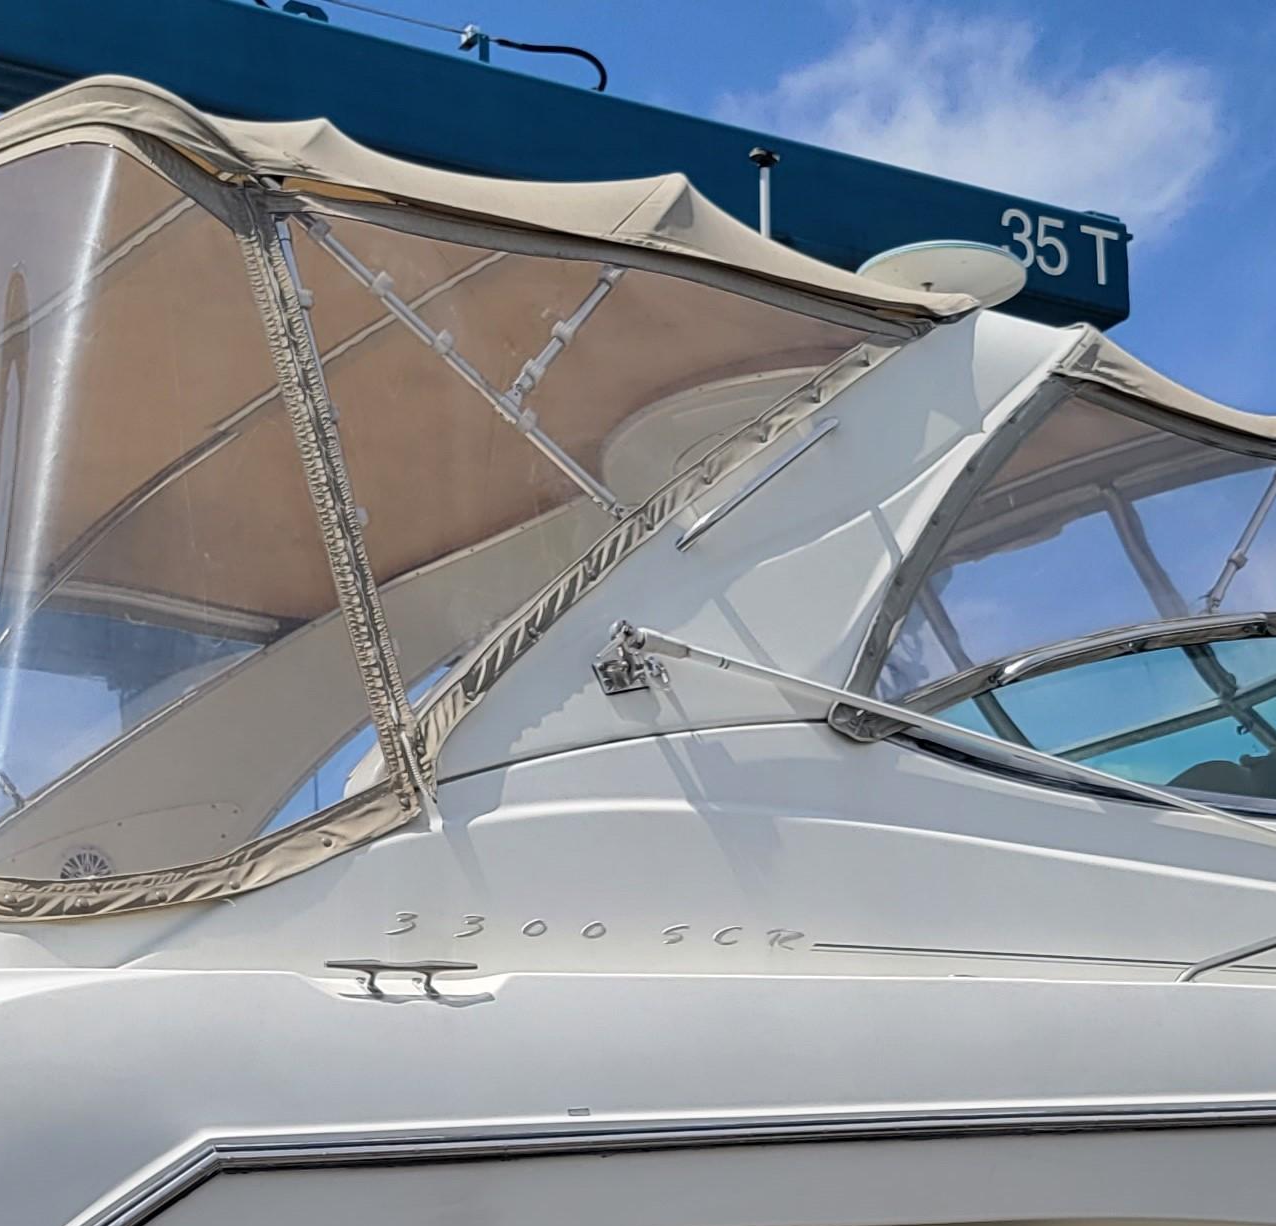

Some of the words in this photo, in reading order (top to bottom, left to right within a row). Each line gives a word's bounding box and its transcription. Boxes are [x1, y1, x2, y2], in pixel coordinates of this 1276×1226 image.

[1000, 208, 1069, 276] 35
[1080, 225, 1119, 285] T
[382, 911, 607, 939] 3300
[661, 923, 805, 951] SCR
